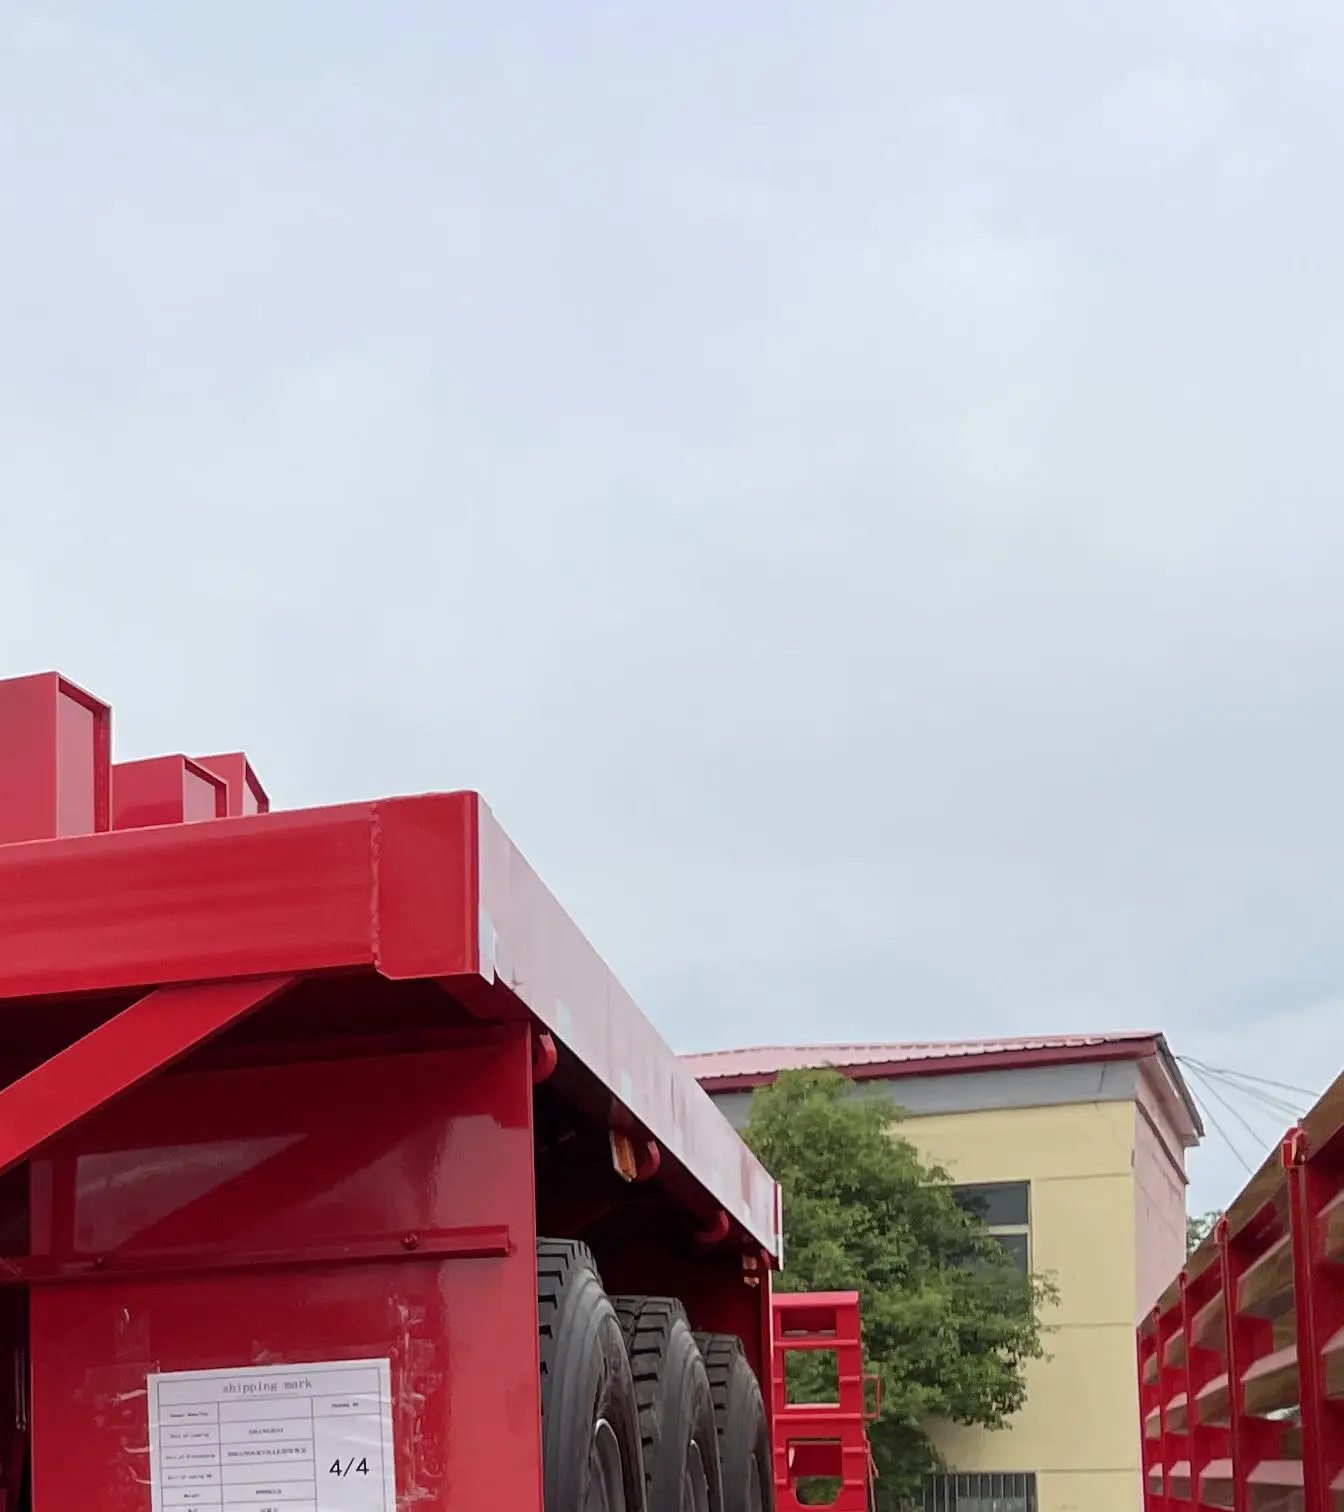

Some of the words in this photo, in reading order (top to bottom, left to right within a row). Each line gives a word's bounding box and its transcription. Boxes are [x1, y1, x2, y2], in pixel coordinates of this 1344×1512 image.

[222, 1380, 278, 1395] shipping
[284, 1378, 312, 1391] mark
[329, 1457, 370, 1478] 4/4
